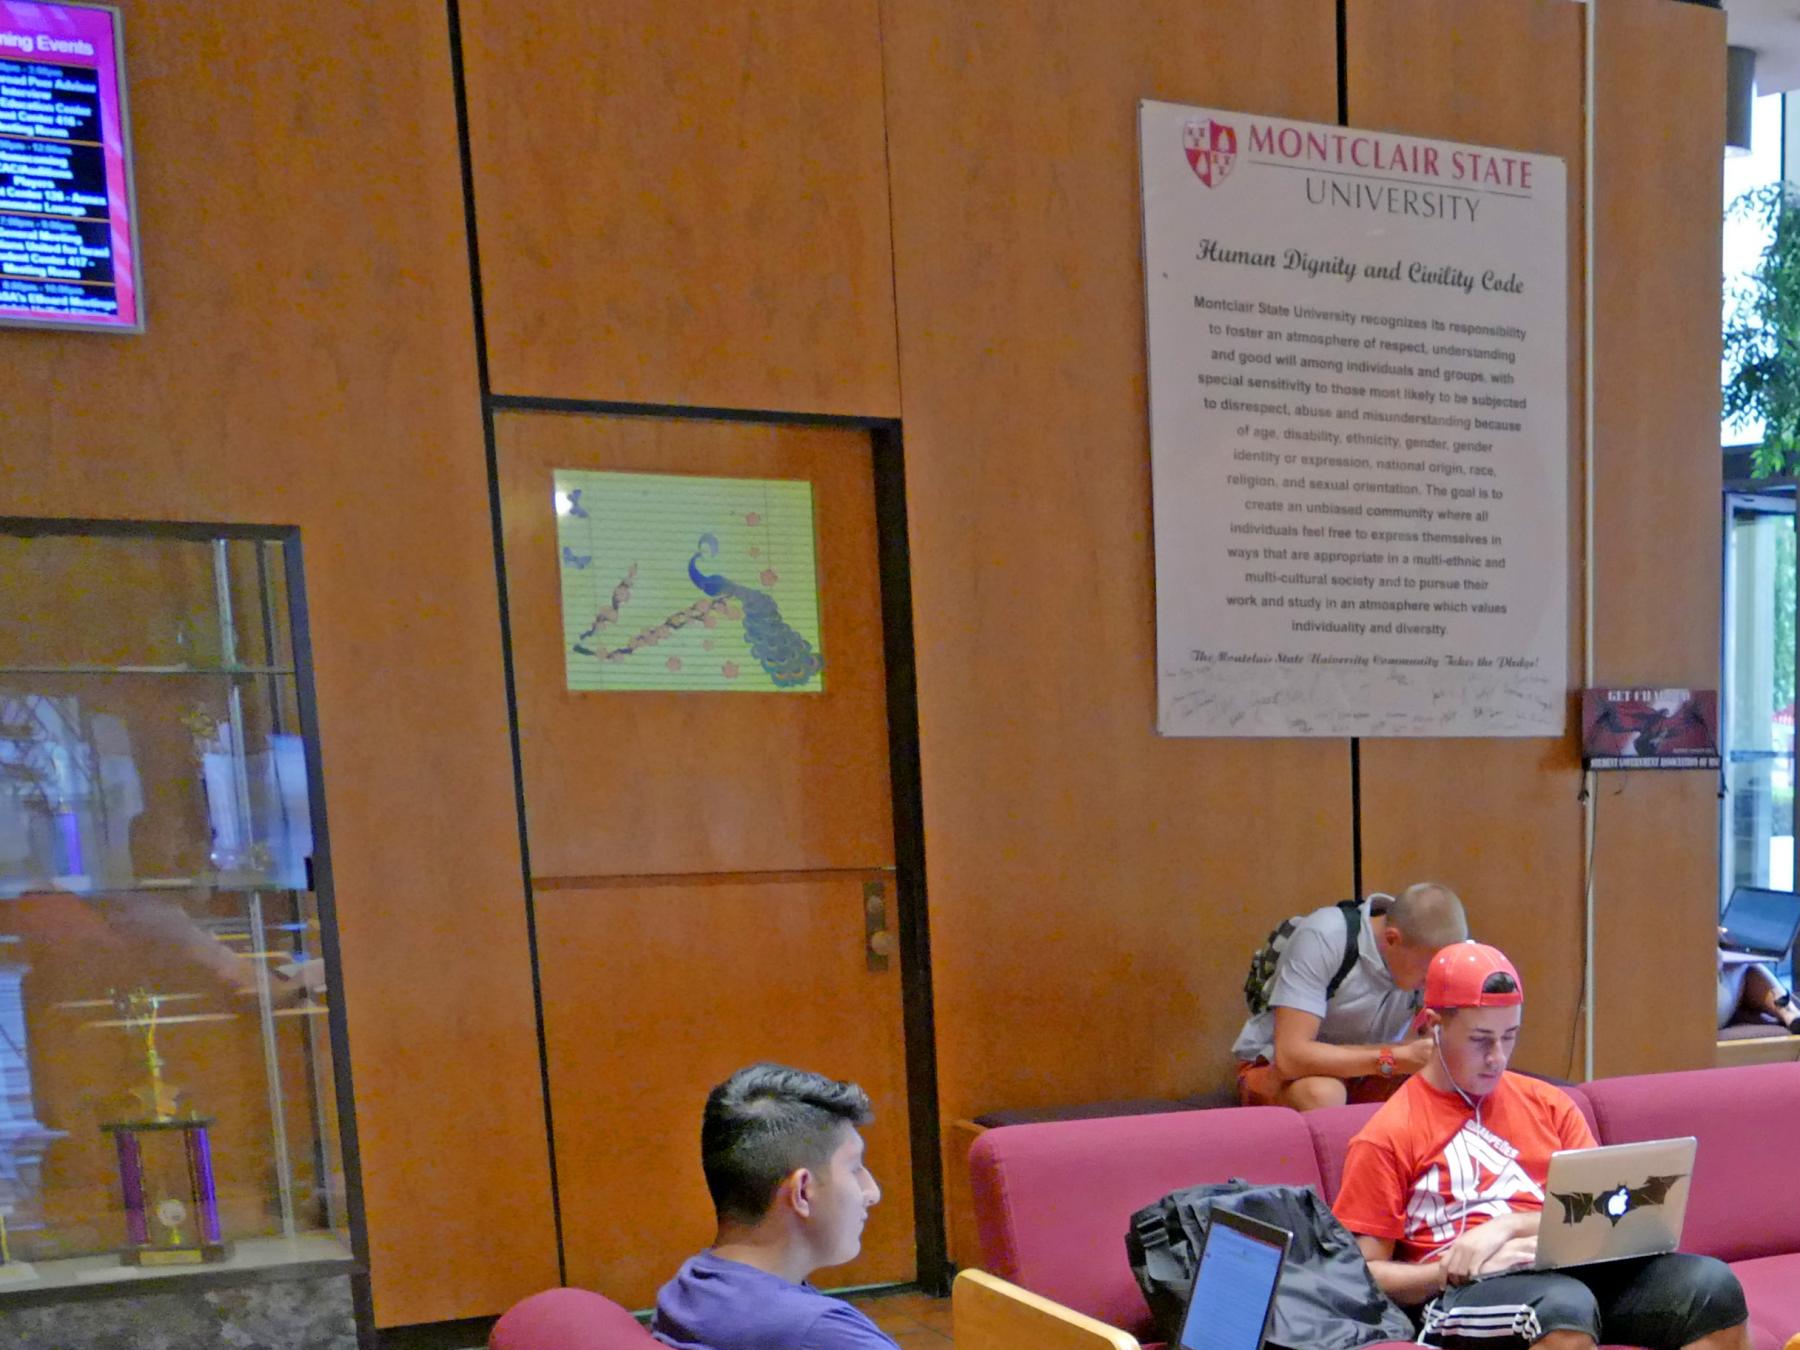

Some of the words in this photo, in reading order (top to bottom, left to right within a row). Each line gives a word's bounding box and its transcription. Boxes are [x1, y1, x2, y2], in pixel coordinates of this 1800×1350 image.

[36, 34, 94, 56] Events
[1248, 124, 1439, 175] MONTCLAIR
[1452, 151, 1532, 189] STATE
[1305, 177, 1480, 222] UNIVERSITY
[1195, 238, 1276, 268] Human
[1283, 248, 1357, 283] Dignity
[1364, 260, 1402, 281] and
[1408, 262, 1474, 294] Civility
[1481, 270, 1524, 294] Code
[1194, 295, 1254, 313] Montclair
[1258, 302, 1290, 317] State
[1294, 306, 1356, 326] University
[1360, 315, 1427, 330] recognizes
[1431, 319, 1446, 331] its
[1449, 323, 1527, 342] responsibility
[1208, 323, 1222, 335] to
[1225, 325, 1263, 338] foster
[1267, 331, 1282, 340] an
[1286, 331, 1360, 348] atmosphere
[1363, 337, 1376, 349] of
[1432, 345, 1516, 365] understanding
[1211, 349, 1235, 361] and
[1238, 352, 1272, 365] good
[1275, 355, 1297, 366] will
[1300, 358, 1343, 373] among
[1347, 361, 1414, 376] individuals
[1417, 367, 1440, 378] and
[1491, 373, 1514, 384] with
[1198, 374, 1243, 387] special
[1247, 377, 1311, 395] sensitivity
[1315, 382, 1328, 393] to
[1331, 383, 1366, 396] those
[1369, 388, 1400, 399] most
[1404, 389, 1435, 404] likely
[1439, 392, 1450, 402] to
[1454, 393, 1468, 404] be
[1472, 396, 1527, 409] subjected
[1203, 397, 1217, 410] to
[1295, 404, 1332, 418] abuse
[1336, 408, 1359, 420] and
[1363, 411, 1471, 431] misunderstanding
[1474, 417, 1522, 432] because
[1237, 424, 1249, 436] of
[1453, 441, 1493, 454] gender
[1233, 448, 1280, 465] identity
[1284, 454, 1297, 464] or
[1376, 460, 1425, 471] national
[1282, 477, 1305, 489] and
[1309, 480, 1349, 491] sexual
[1426, 483, 1448, 496] The
[1450, 487, 1476, 500] goal
[1478, 488, 1489, 499] is
[1491, 489, 1503, 500] to
[1244, 501, 1283, 511] create
[1287, 503, 1302, 512] an
[1306, 503, 1363, 516] unbiased
[1366, 507, 1434, 522] community
[1437, 509, 1472, 521] where
[1475, 510, 1489, 522] all
[1230, 522, 1298, 536] individuals
[1302, 525, 1324, 537] feel
[1328, 526, 1351, 539] free
[1355, 529, 1368, 539] to
[1370, 531, 1419, 543] express
[1422, 532, 1488, 545] themselves
[1491, 535, 1502, 545] in
[1227, 548, 1259, 560] ways
[1263, 548, 1287, 559] that
[1291, 551, 1309, 560] are
[1313, 552, 1384, 565] appropriate
[1387, 552, 1399, 563] in
[1402, 556, 1409, 564] a
[1412, 554, 1481, 568] multi-ethnic
[1484, 558, 1506, 568] and
[1245, 571, 1327, 585] multi-cultural
[1331, 576, 1375, 589] society
[1379, 576, 1401, 587] and
[1404, 577, 1416, 588] to
[1419, 579, 1460, 591] pursue
[1463, 579, 1489, 590] their
[1226, 594, 1258, 607] work
[1261, 596, 1284, 607] and
[1288, 597, 1321, 611] study
[1326, 598, 1337, 608] in
[1340, 600, 1355, 609] an
[1359, 599, 1430, 612] atmosphere
[1433, 601, 1468, 613] which
[1471, 602, 1507, 614] values
[1292, 620, 1366, 636] individuality
[1369, 622, 1392, 634] and
